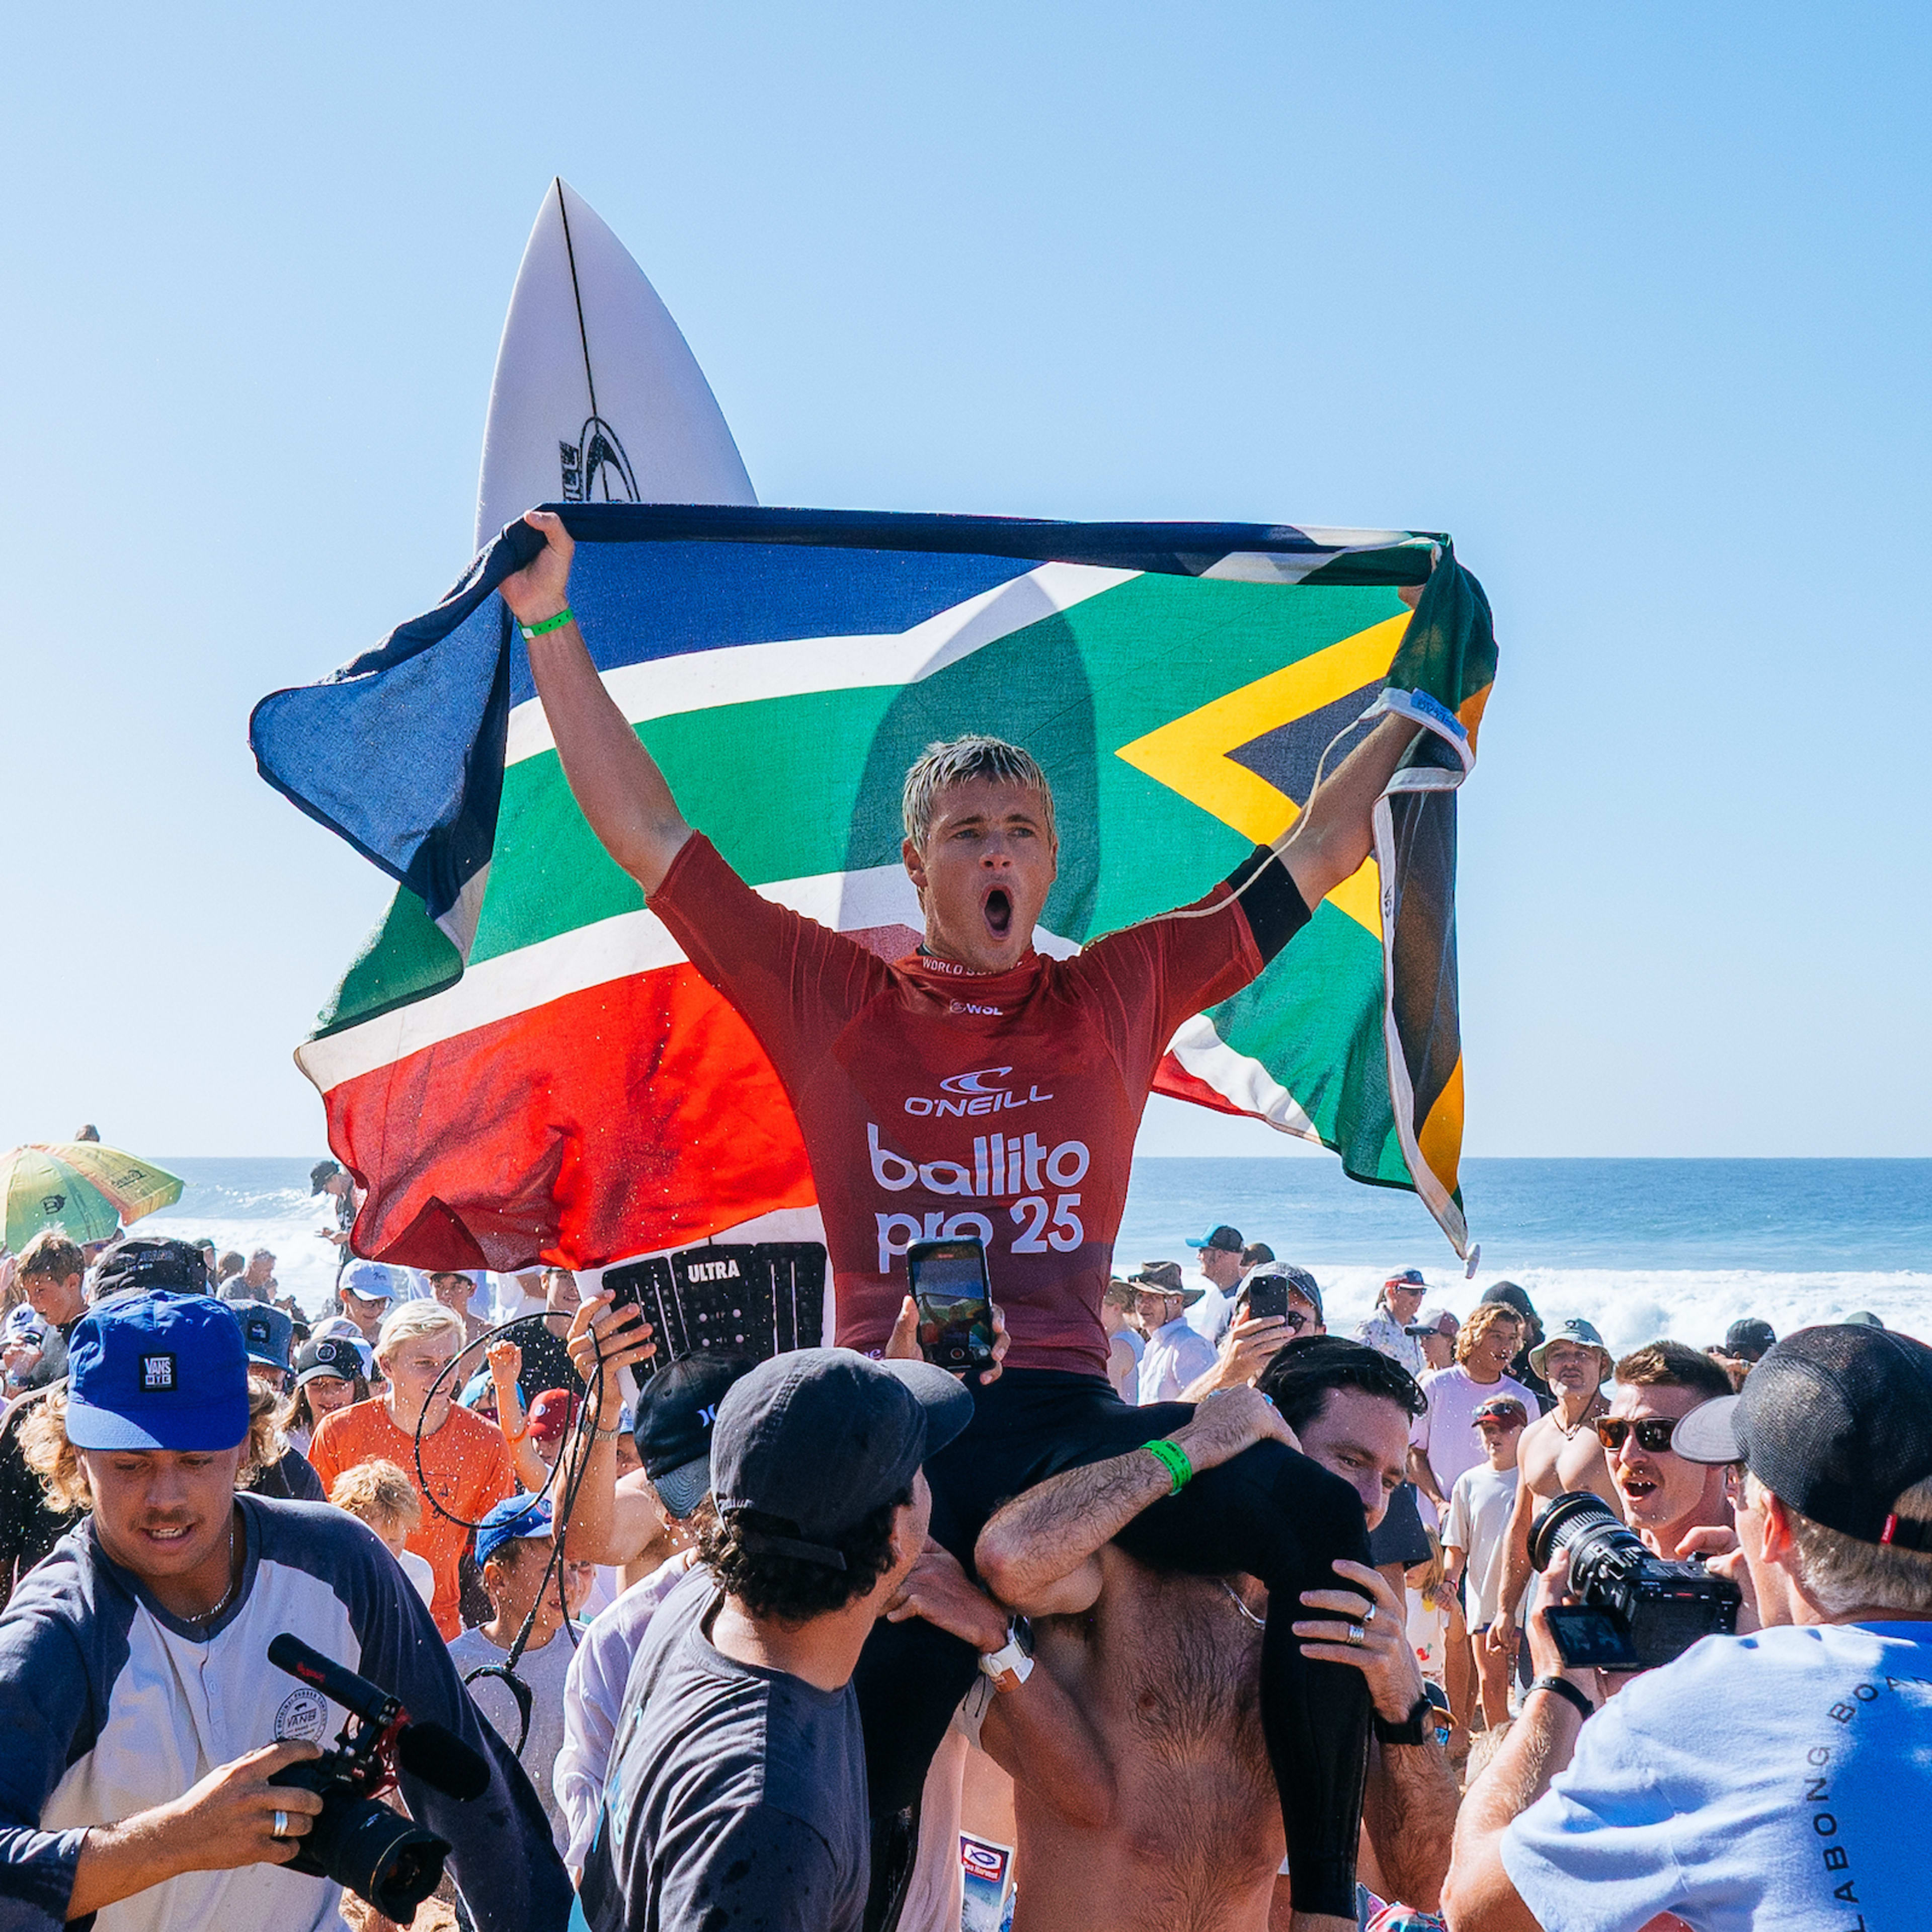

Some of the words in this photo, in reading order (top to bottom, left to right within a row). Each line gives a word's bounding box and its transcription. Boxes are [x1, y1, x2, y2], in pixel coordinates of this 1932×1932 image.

[922, 956, 963, 975] WORLD
[966, 1003, 1004, 1015] WSL
[904, 1085, 1054, 1117] O'NEILL
[867, 1121, 1090, 1196] ballito
[874, 1211, 994, 1274] pro
[1009, 1193, 1084, 1254] 25
[687, 1259, 741, 1283] ULTRA
[143, 1357, 172, 1374] VANS
[287, 1708, 316, 1728] VANS
